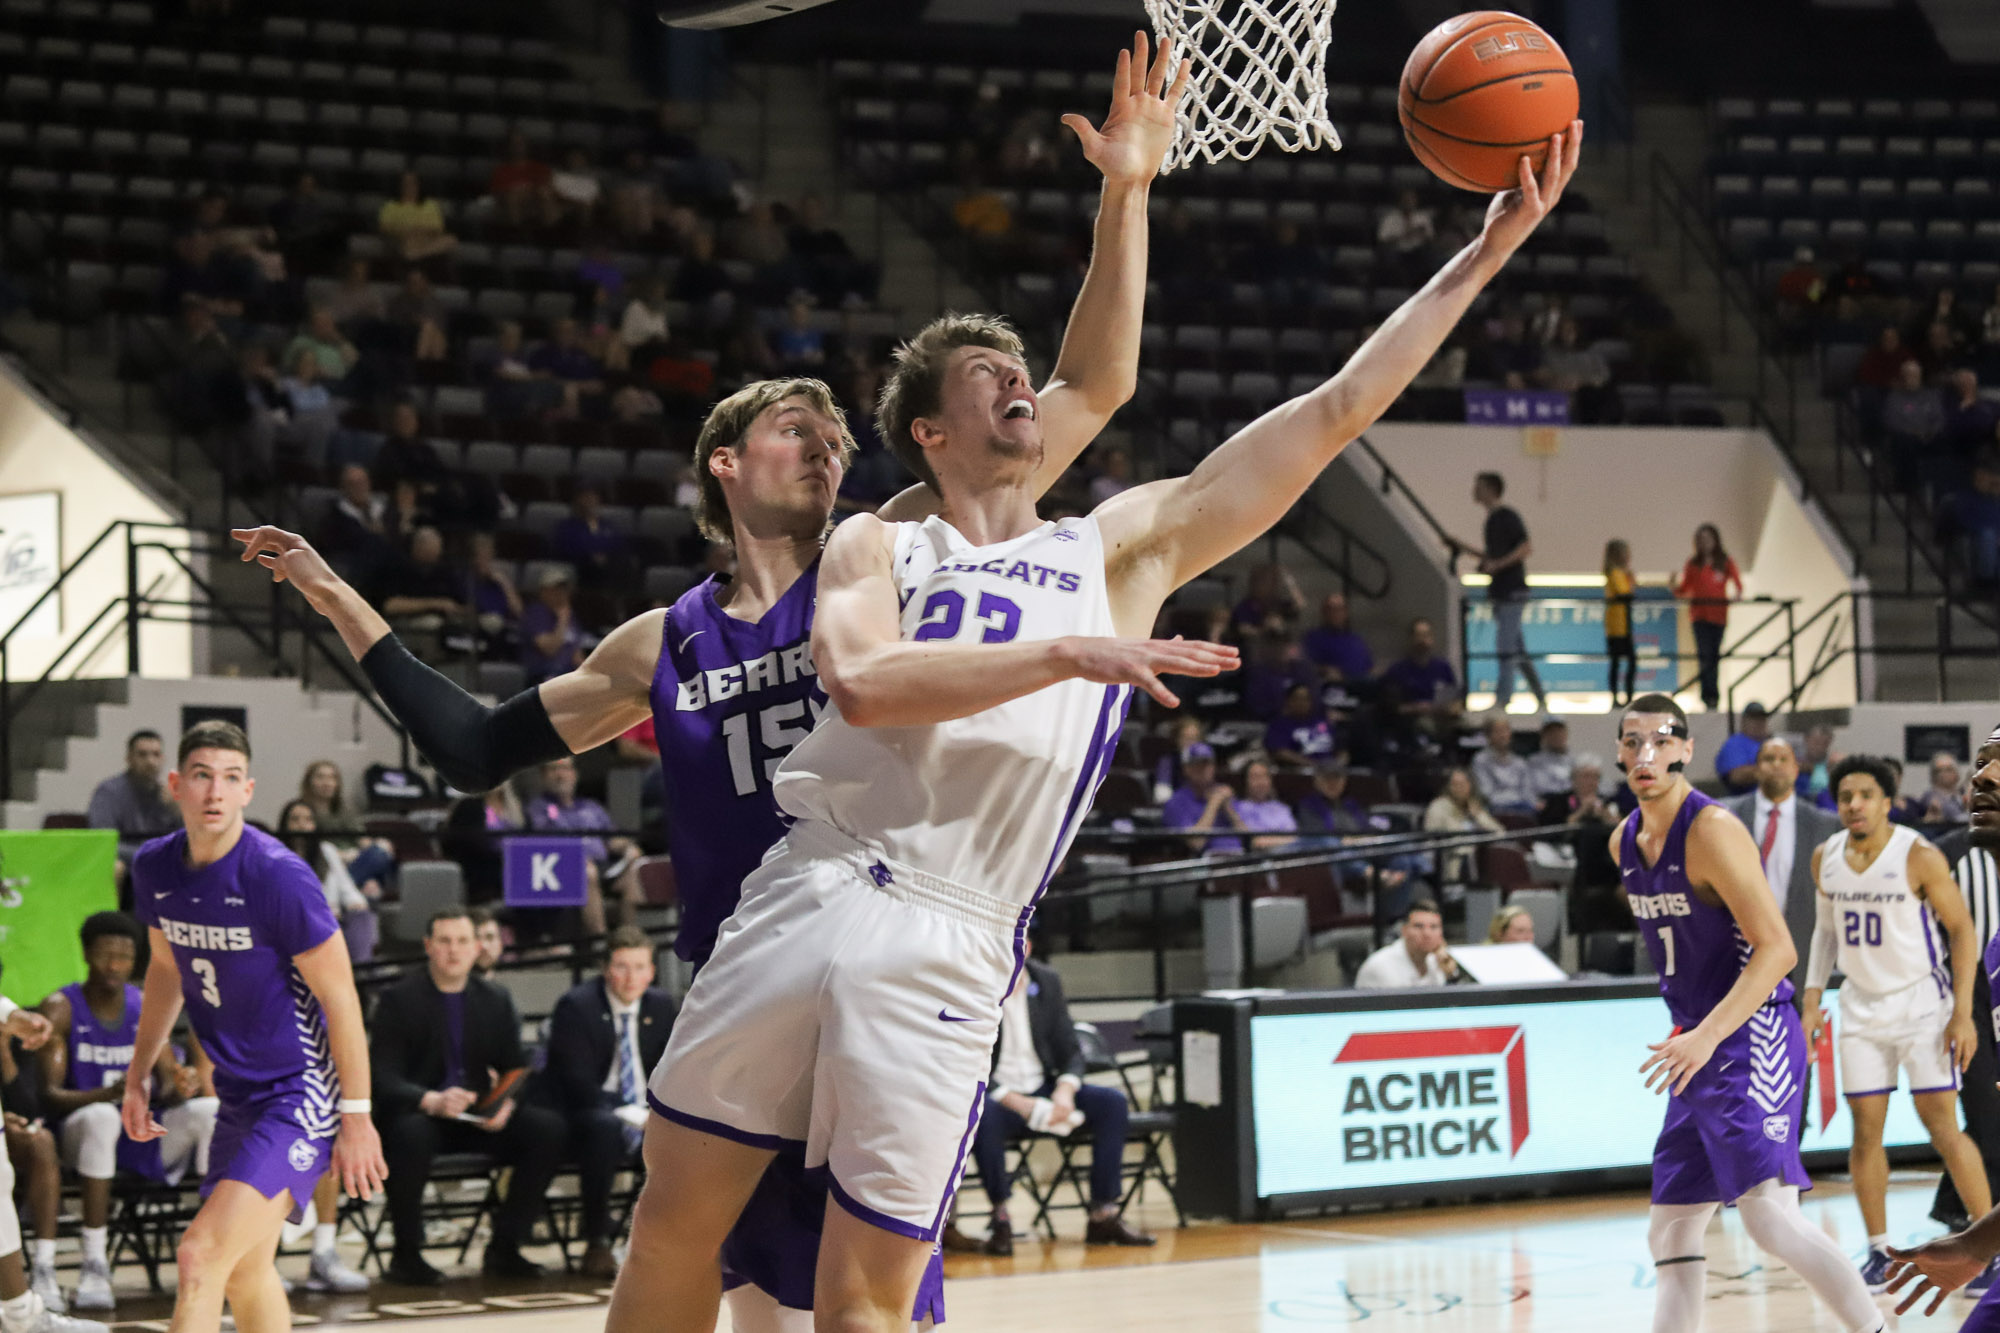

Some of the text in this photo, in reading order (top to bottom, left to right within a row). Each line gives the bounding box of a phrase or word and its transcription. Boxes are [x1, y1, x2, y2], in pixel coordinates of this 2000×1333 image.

[930, 557, 1083, 593] CATS
[675, 641, 819, 712] BEAR
[531, 852, 562, 892] K
[1657, 925, 1676, 977] 1
[1844, 911, 1882, 947] 20
[191, 957, 222, 1009] 3
[1343, 1068, 1498, 1115] ACME
[1344, 1117, 1501, 1163] BRICK
